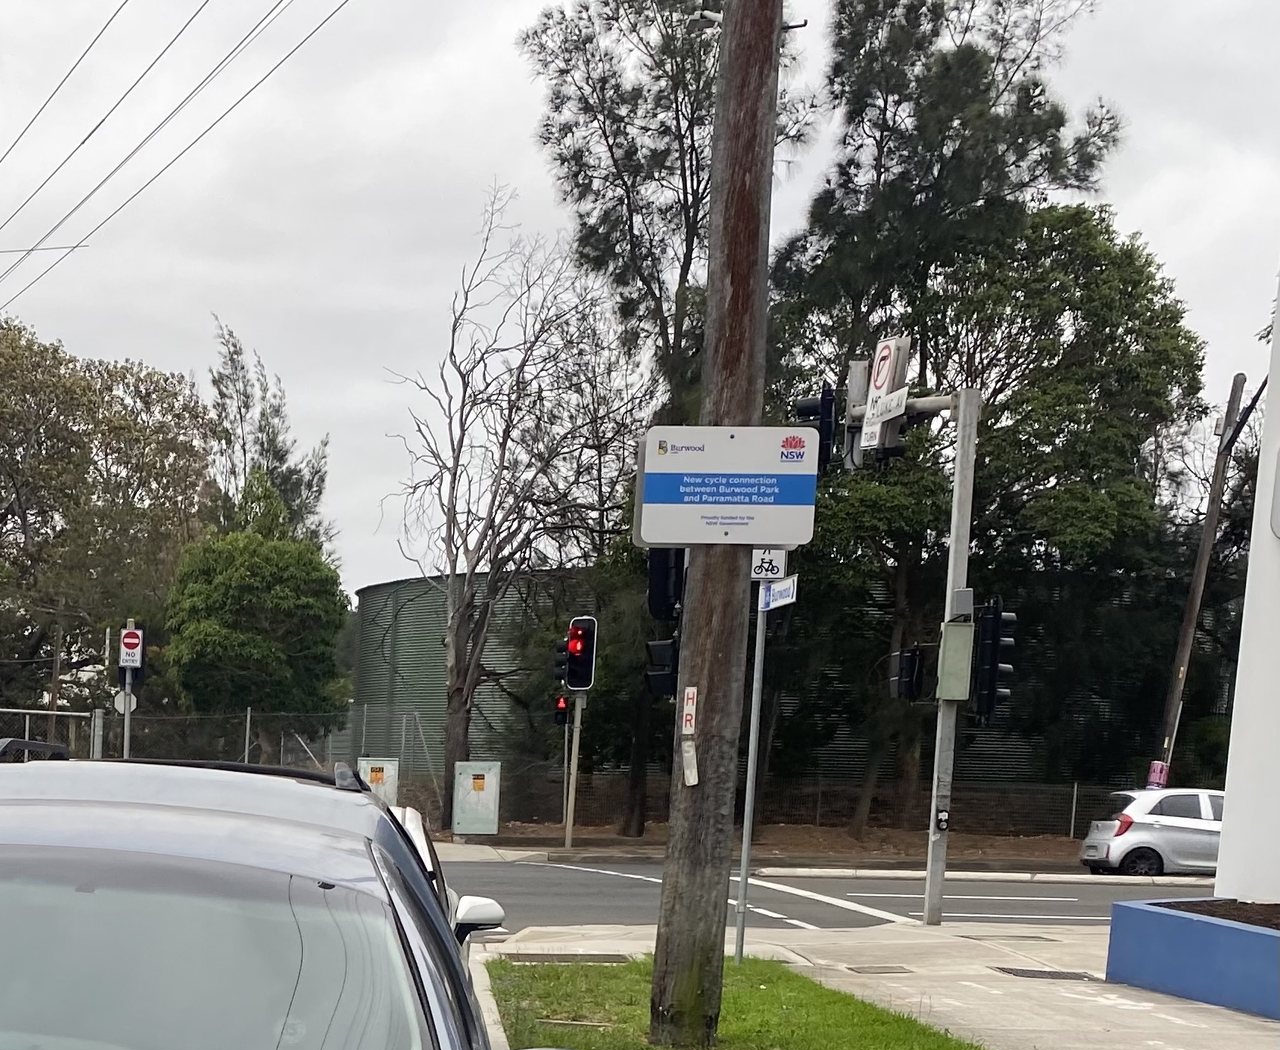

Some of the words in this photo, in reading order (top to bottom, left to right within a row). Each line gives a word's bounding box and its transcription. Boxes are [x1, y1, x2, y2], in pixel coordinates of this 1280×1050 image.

[670, 444, 705, 452] Burwood
[780, 451, 805, 460] NSW
[683, 476, 703, 484] New
[704, 476, 727, 485] cycle
[729, 476, 777, 484] connection
[760, 486, 780, 494] Park
[702, 495, 750, 503] Parramatta
[751, 495, 775, 503] Road
